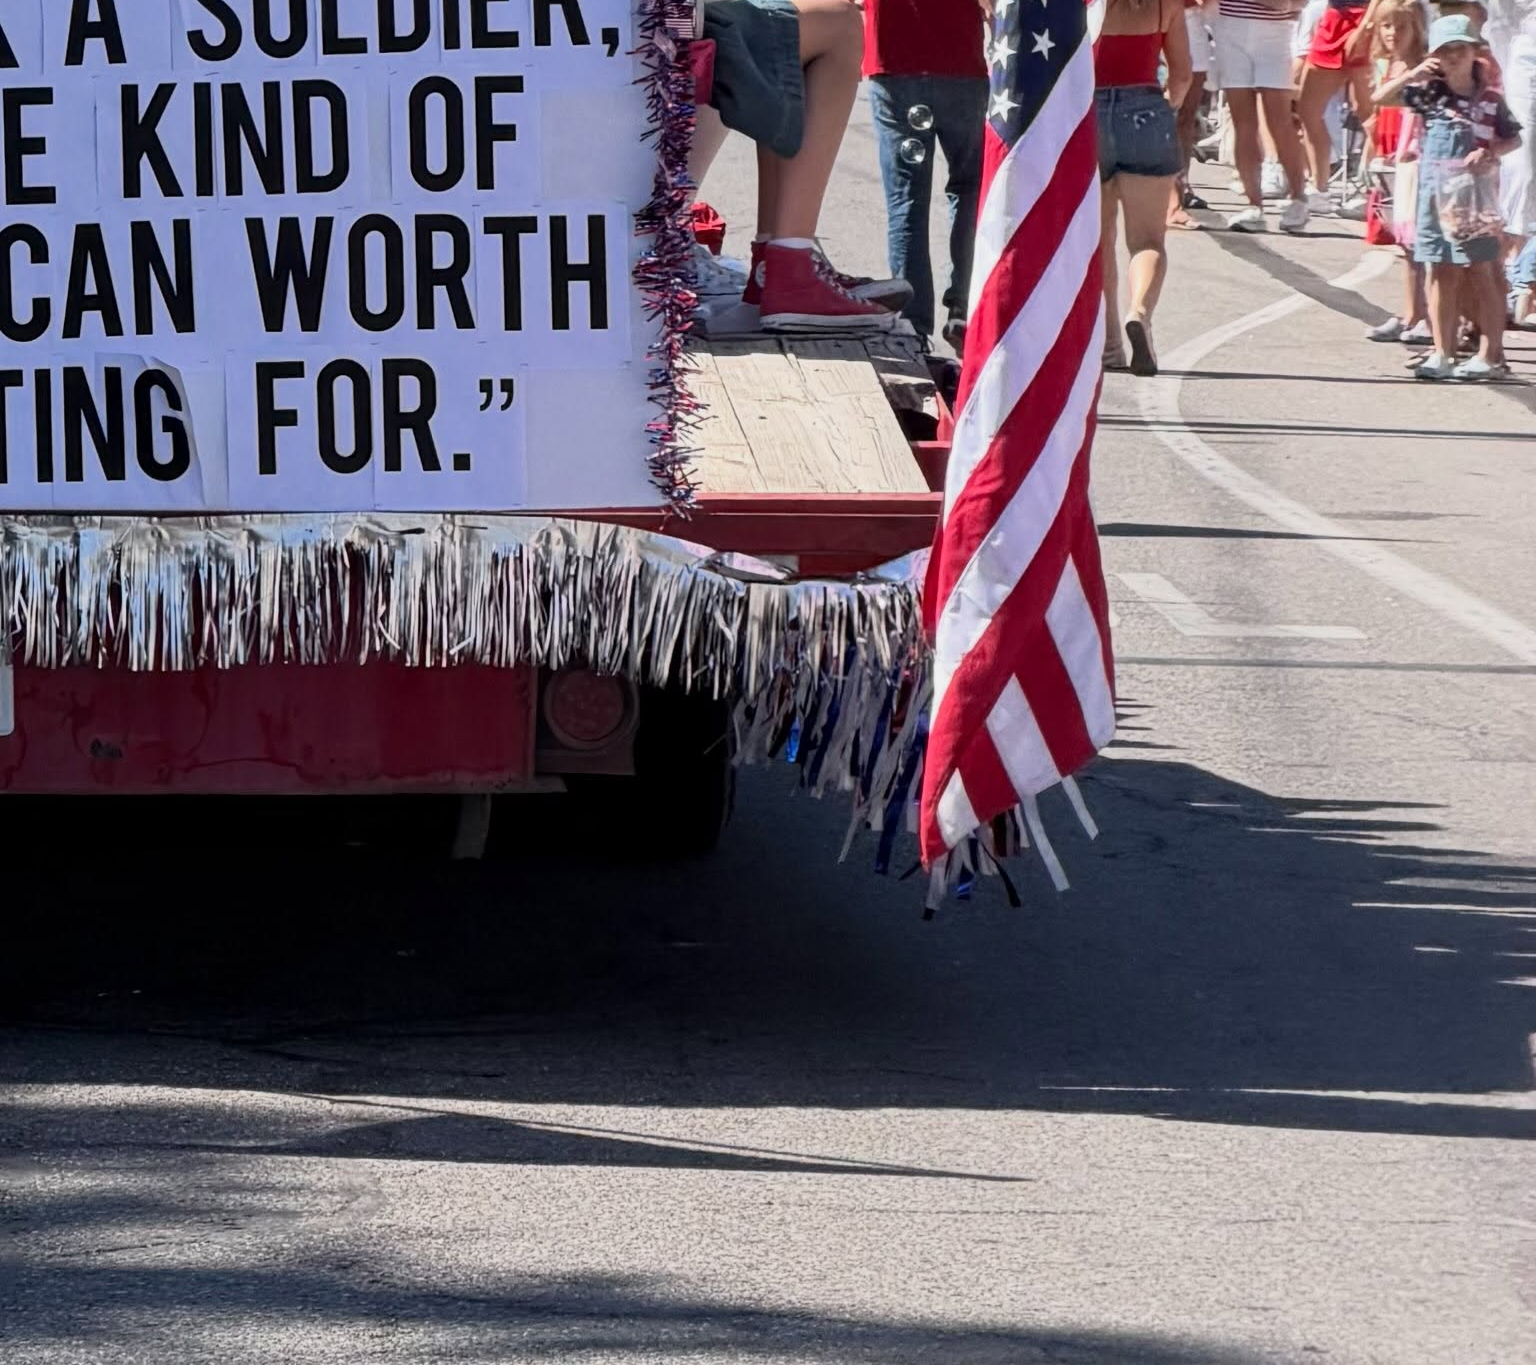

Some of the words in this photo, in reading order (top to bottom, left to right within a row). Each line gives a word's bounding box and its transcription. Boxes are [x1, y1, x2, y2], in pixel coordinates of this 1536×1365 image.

[121, 79, 350, 199] KIND
[408, 75, 524, 192] OF
[244, 213, 608, 333] WORTH
